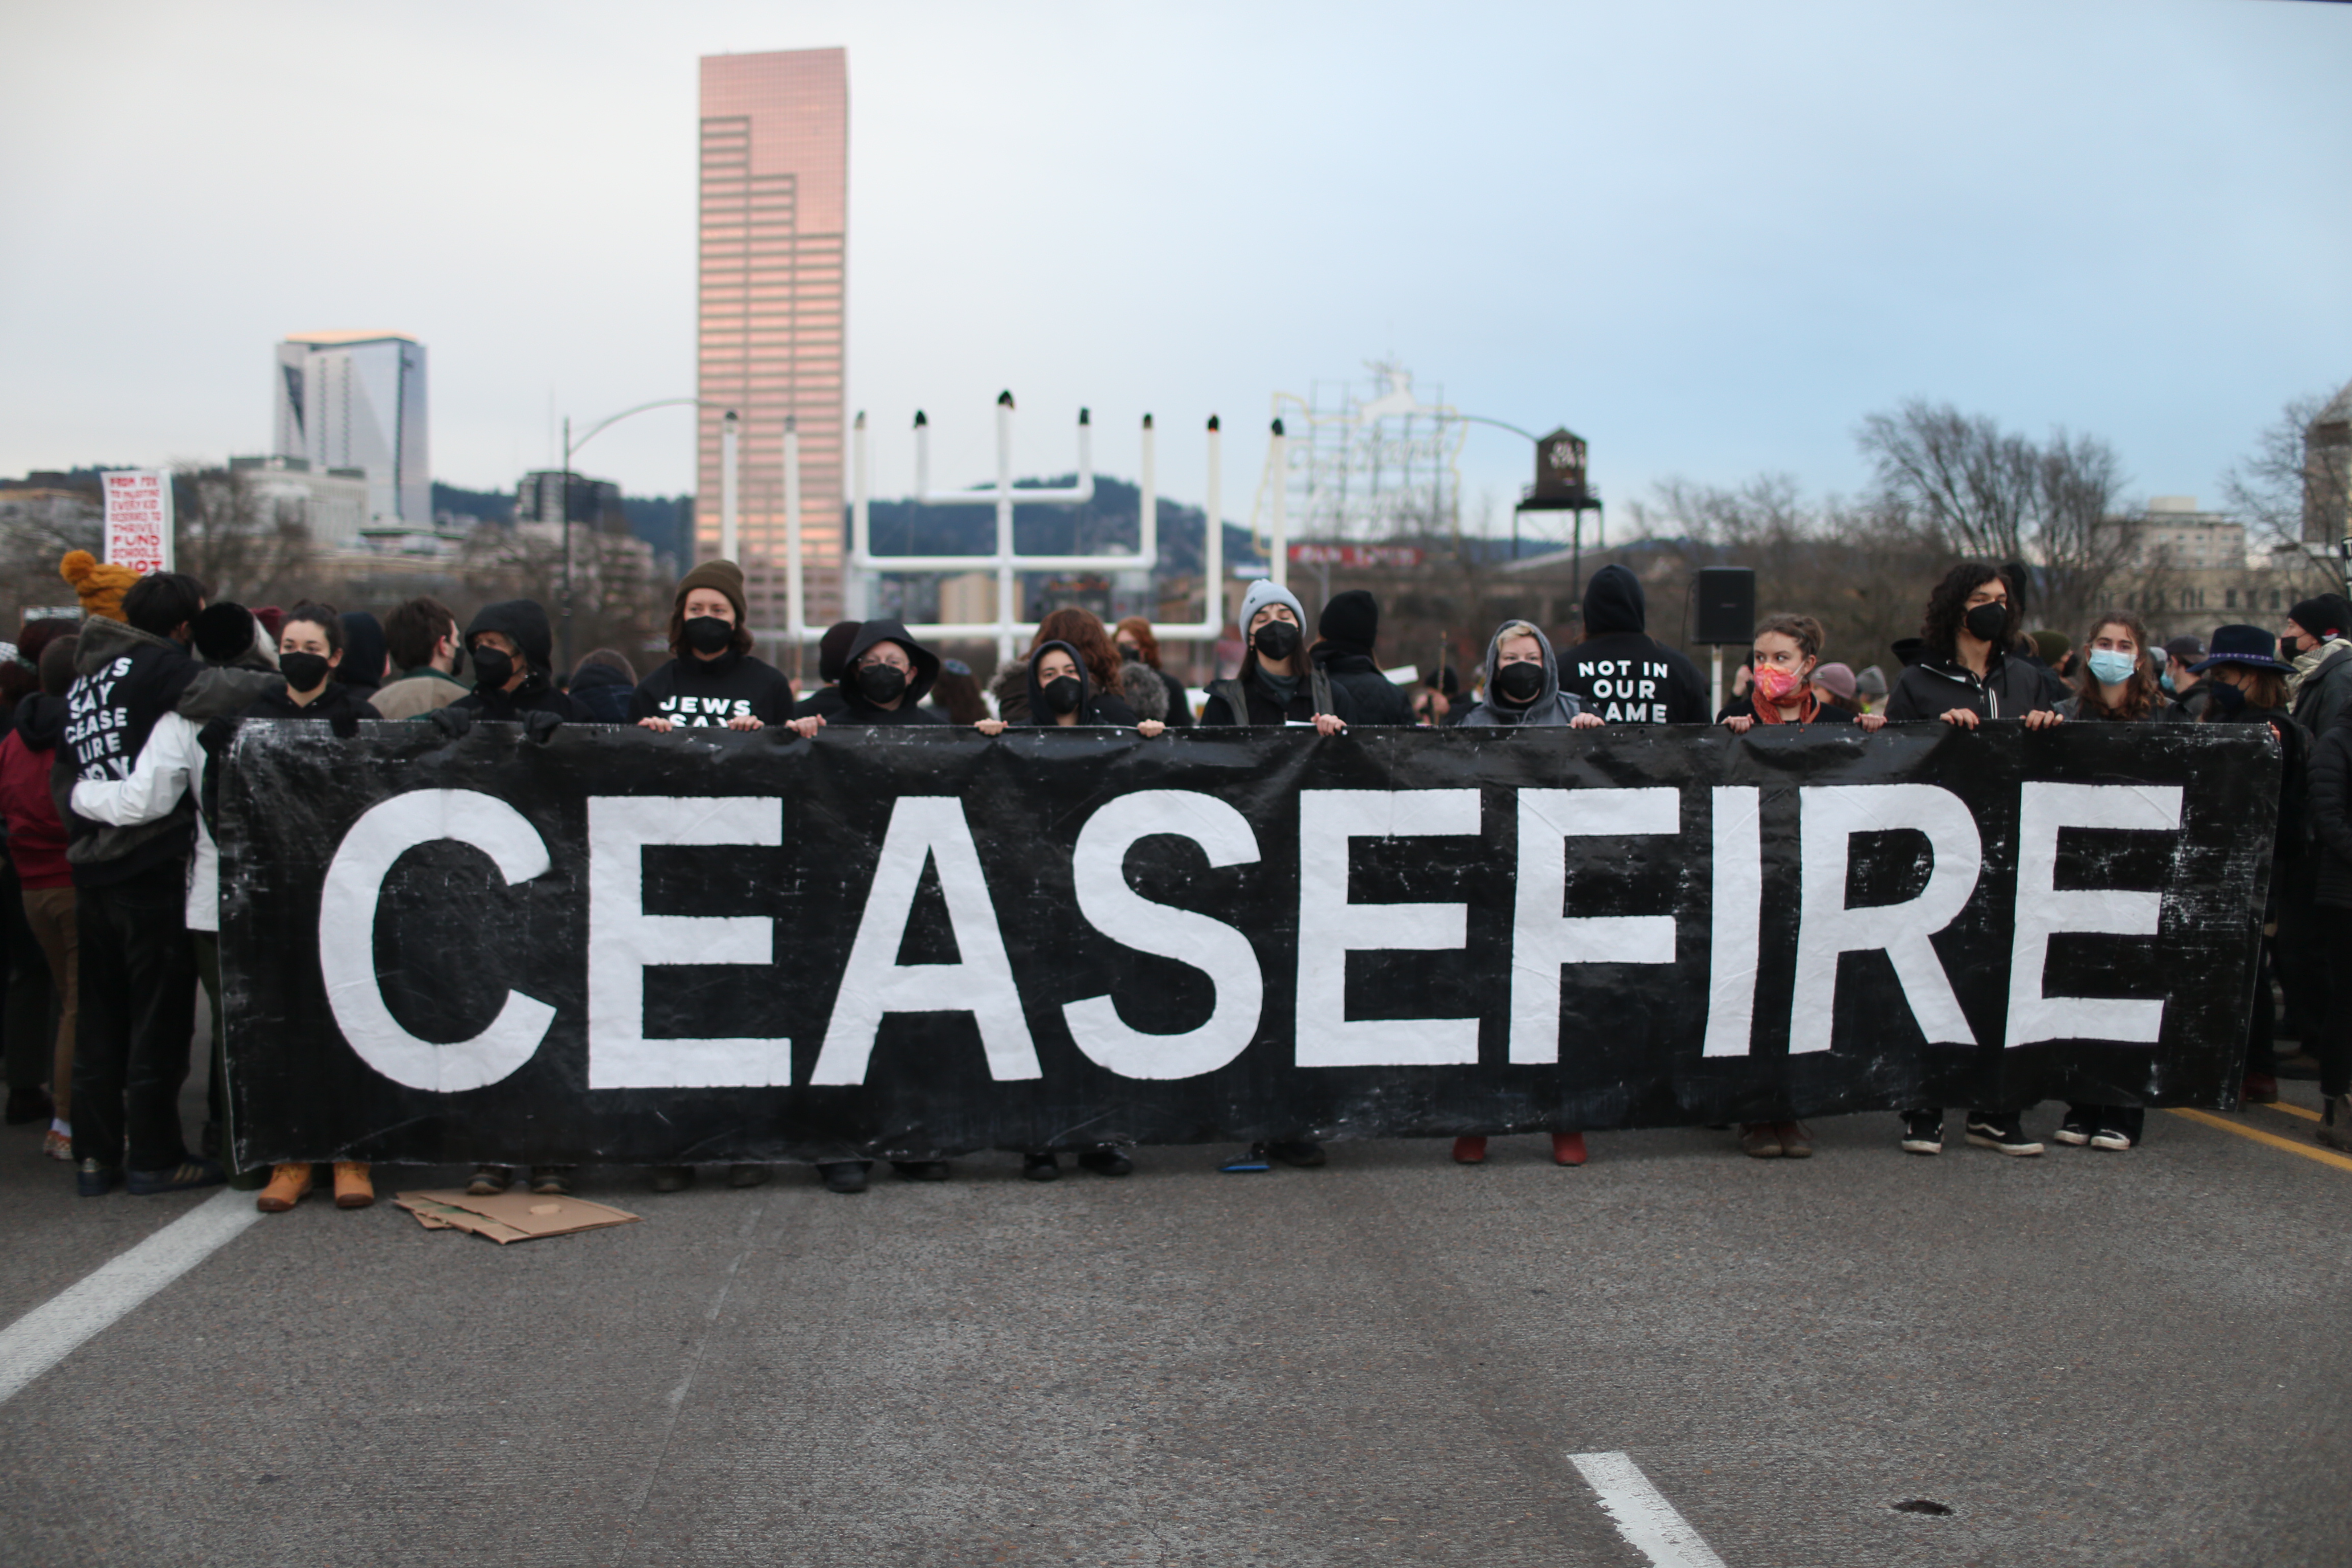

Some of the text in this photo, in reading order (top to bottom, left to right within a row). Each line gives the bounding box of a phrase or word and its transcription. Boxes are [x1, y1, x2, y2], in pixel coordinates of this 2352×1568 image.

[113, 534, 161, 546] FUND
[1578, 659, 1668, 679] NOT IN
[1592, 678, 1656, 700] OUR
[70, 681, 116, 720] SAY
[659, 695, 751, 717] JEWS
[1592, 701, 1668, 724] AME
[65, 706, 128, 745] CEASE
[320, 781, 2185, 1092] CEASEFIRE
